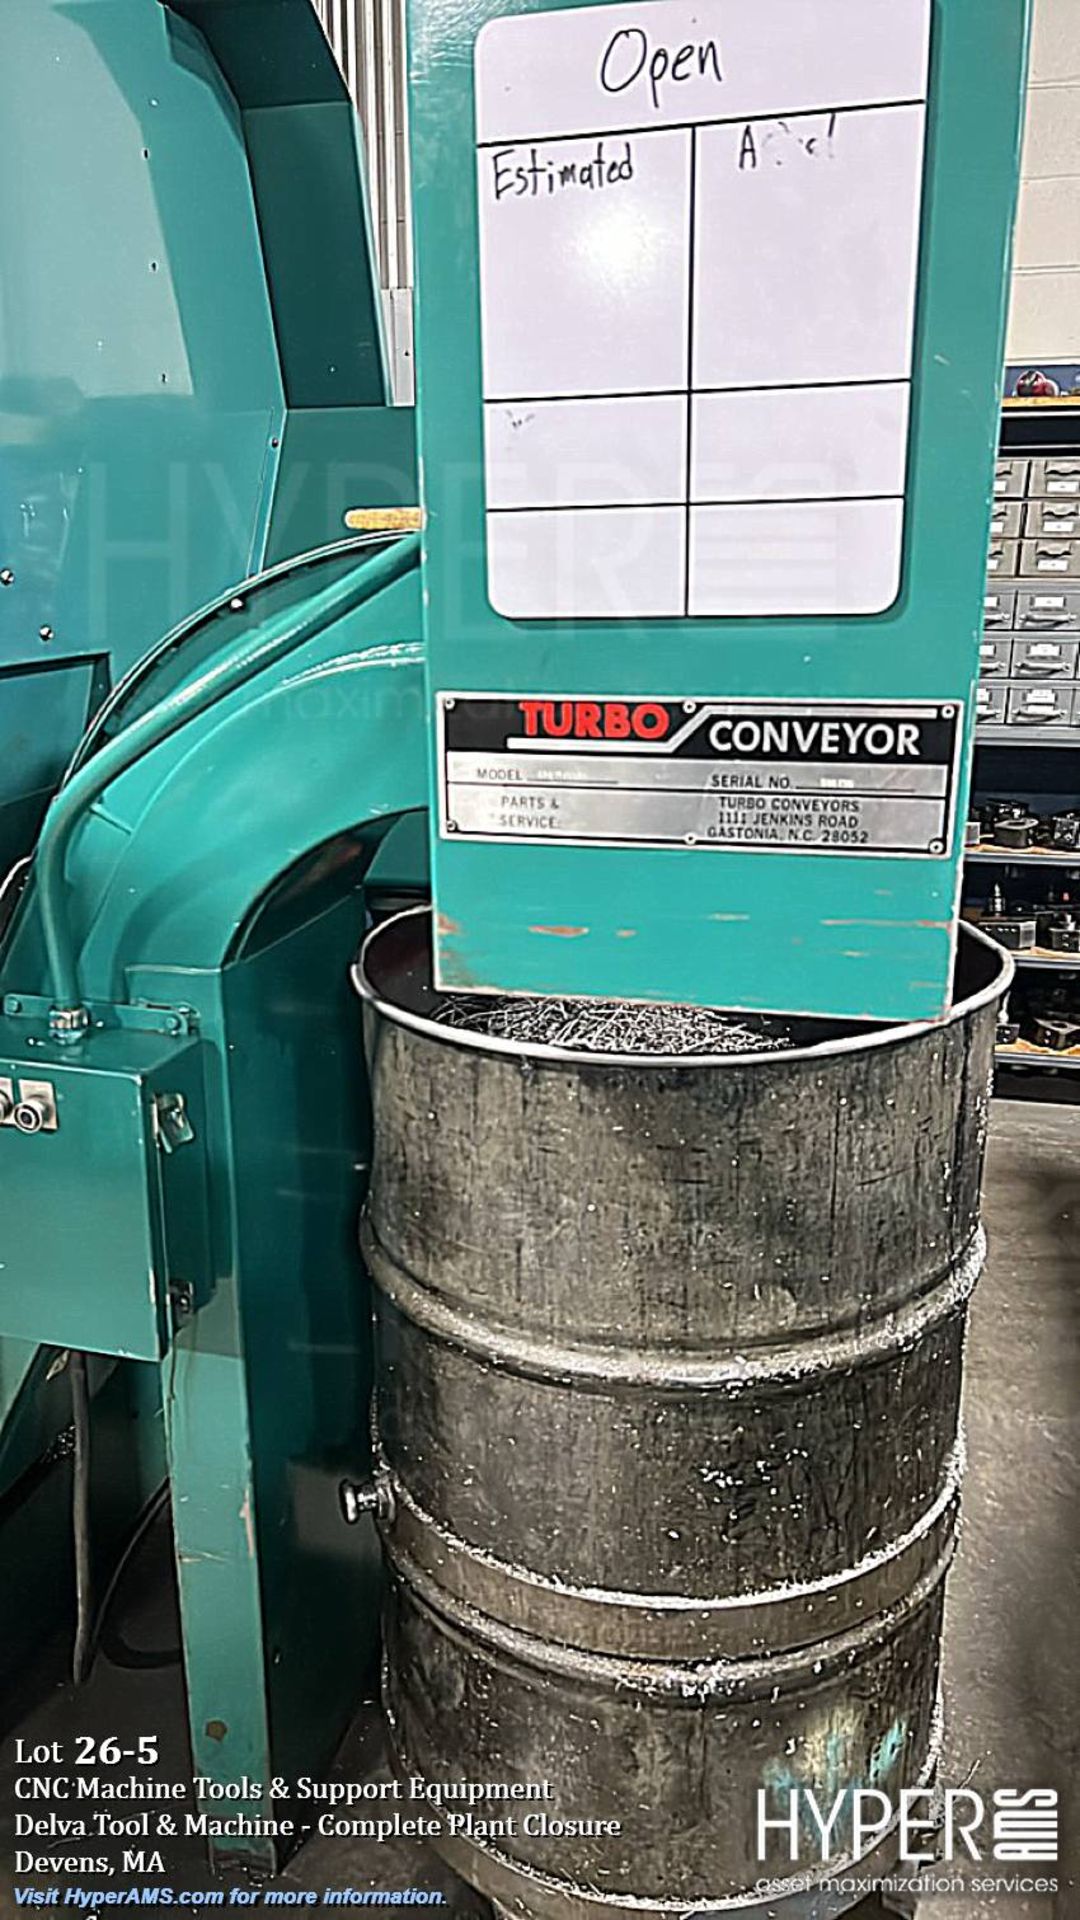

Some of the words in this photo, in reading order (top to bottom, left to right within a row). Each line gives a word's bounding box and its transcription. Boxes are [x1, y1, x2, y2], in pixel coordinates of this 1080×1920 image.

[600, 28, 723, 108] Open
[493, 141, 633, 201] Estimated
[518, 700, 670, 739] TURBO
[709, 720, 921, 756] CONVEYOR
[477, 768, 523, 781] MODEL
[711, 774, 762, 789] SERIAL
[769, 776, 793, 790] NO.
[501, 795, 546, 809] PARTS
[551, 797, 560, 809] &
[719, 796, 766, 810] TURBO
[771, 797, 860, 811] CONVEYORS
[718, 812, 746, 825] 1111
[751, 813, 813, 827] JENKINS
[818, 814, 859, 829] ROAD
[822, 829, 869, 844] 28052
